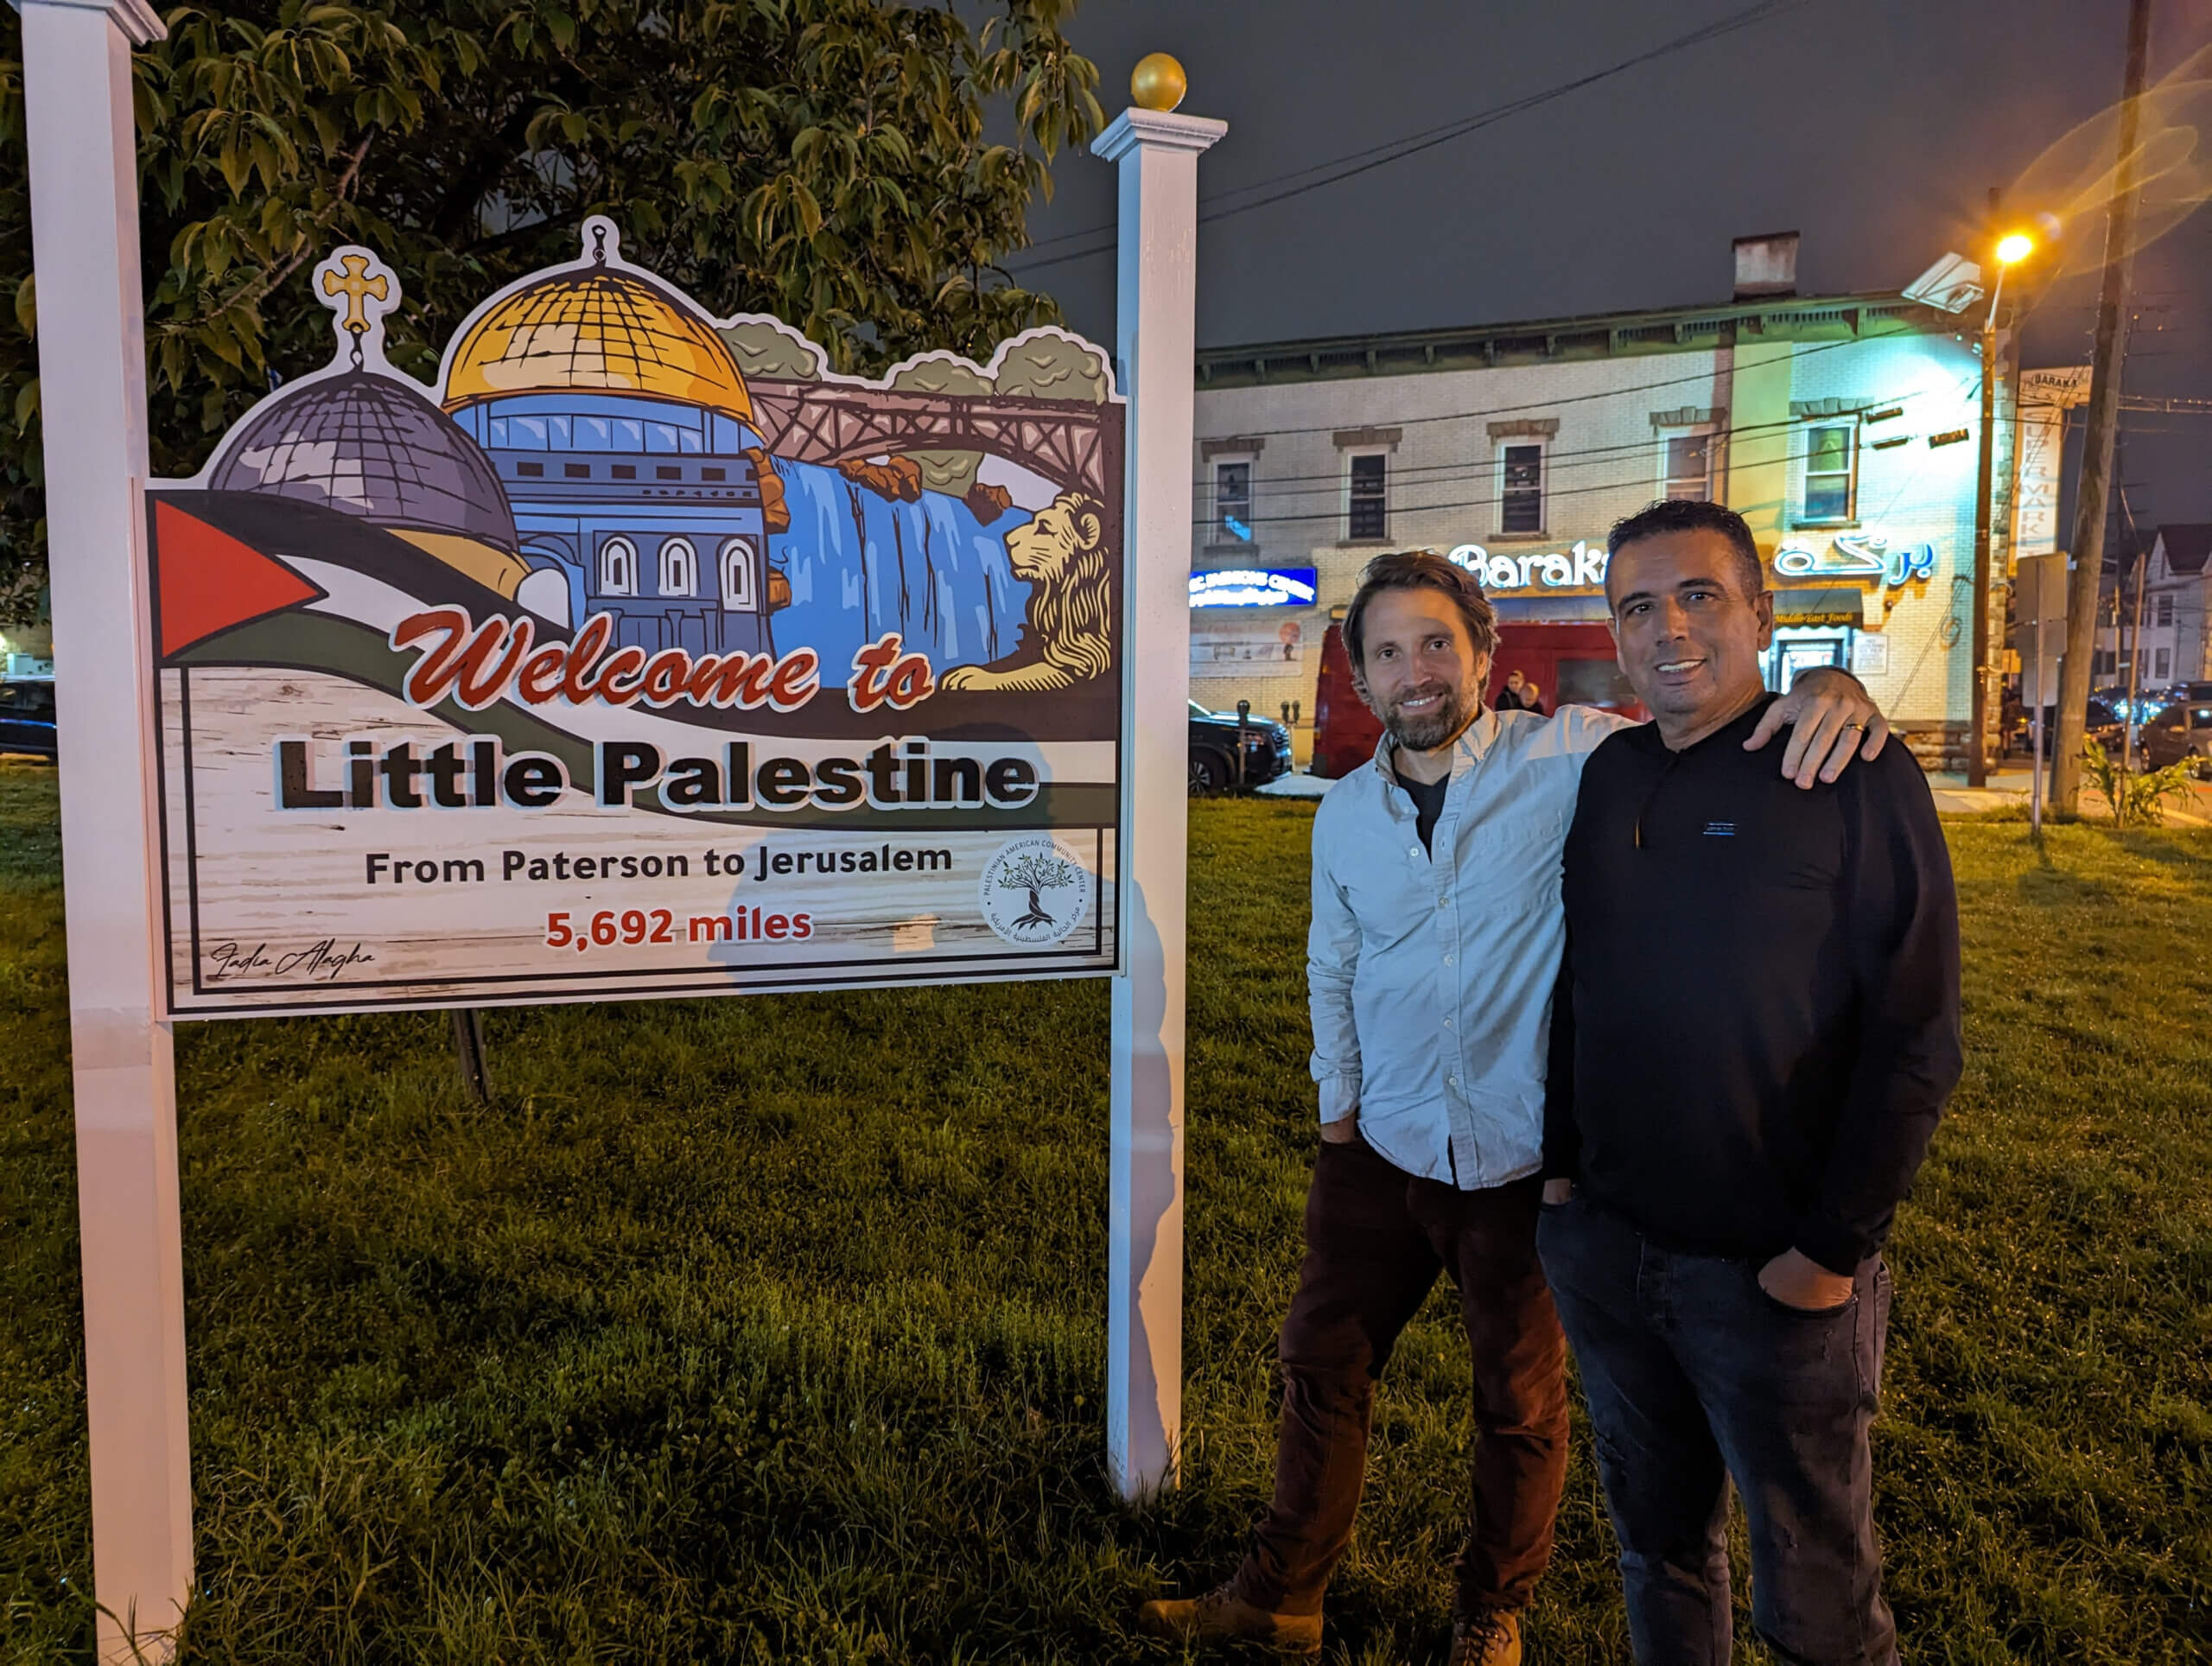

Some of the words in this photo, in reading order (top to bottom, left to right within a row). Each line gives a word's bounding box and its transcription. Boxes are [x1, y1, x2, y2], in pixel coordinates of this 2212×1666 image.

[1447, 540, 1611, 588] Barak
[1774, 533, 1935, 586] بركة
[393, 608, 818, 709] Welcome
[849, 635, 934, 710] to
[277, 739, 567, 810] Little
[601, 740, 1038, 807] Palestine
[365, 853, 485, 885] From
[502, 849, 690, 881] Paterson
[704, 848, 745, 878] to
[753, 843, 952, 881] Jerusalem
[983, 854, 1006, 896] PALESTINIAN
[1005, 839, 1040, 856] AMERICAN
[1041, 839, 1078, 866] COMMUNITY
[1074, 866, 1086, 893] CENTER
[545, 908, 673, 952] 5,692
[689, 904, 813, 942] miles
